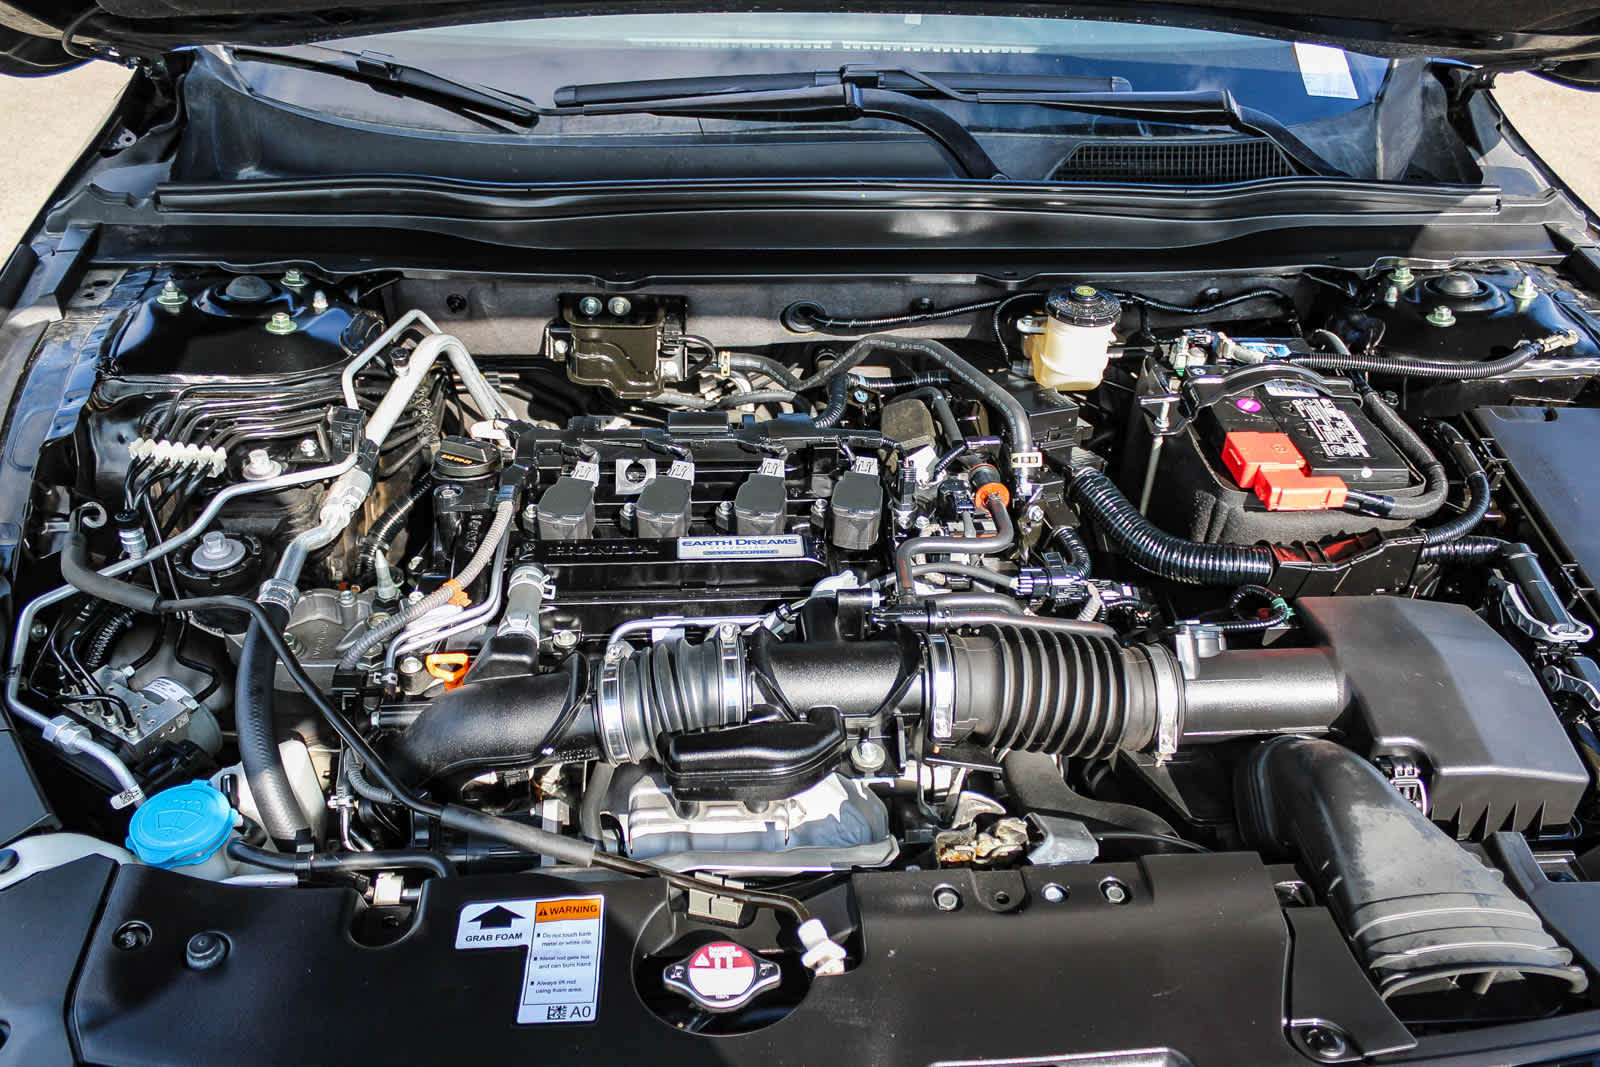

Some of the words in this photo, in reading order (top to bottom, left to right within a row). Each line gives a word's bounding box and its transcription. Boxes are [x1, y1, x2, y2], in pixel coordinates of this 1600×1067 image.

[682, 539, 733, 547] EARTH
[735, 538, 798, 546] DREAMS
[549, 904, 598, 915] WARNING
[465, 933, 493, 943] GRAB
[495, 932, 523, 941] FOAM
[569, 1005, 592, 1018] A0
